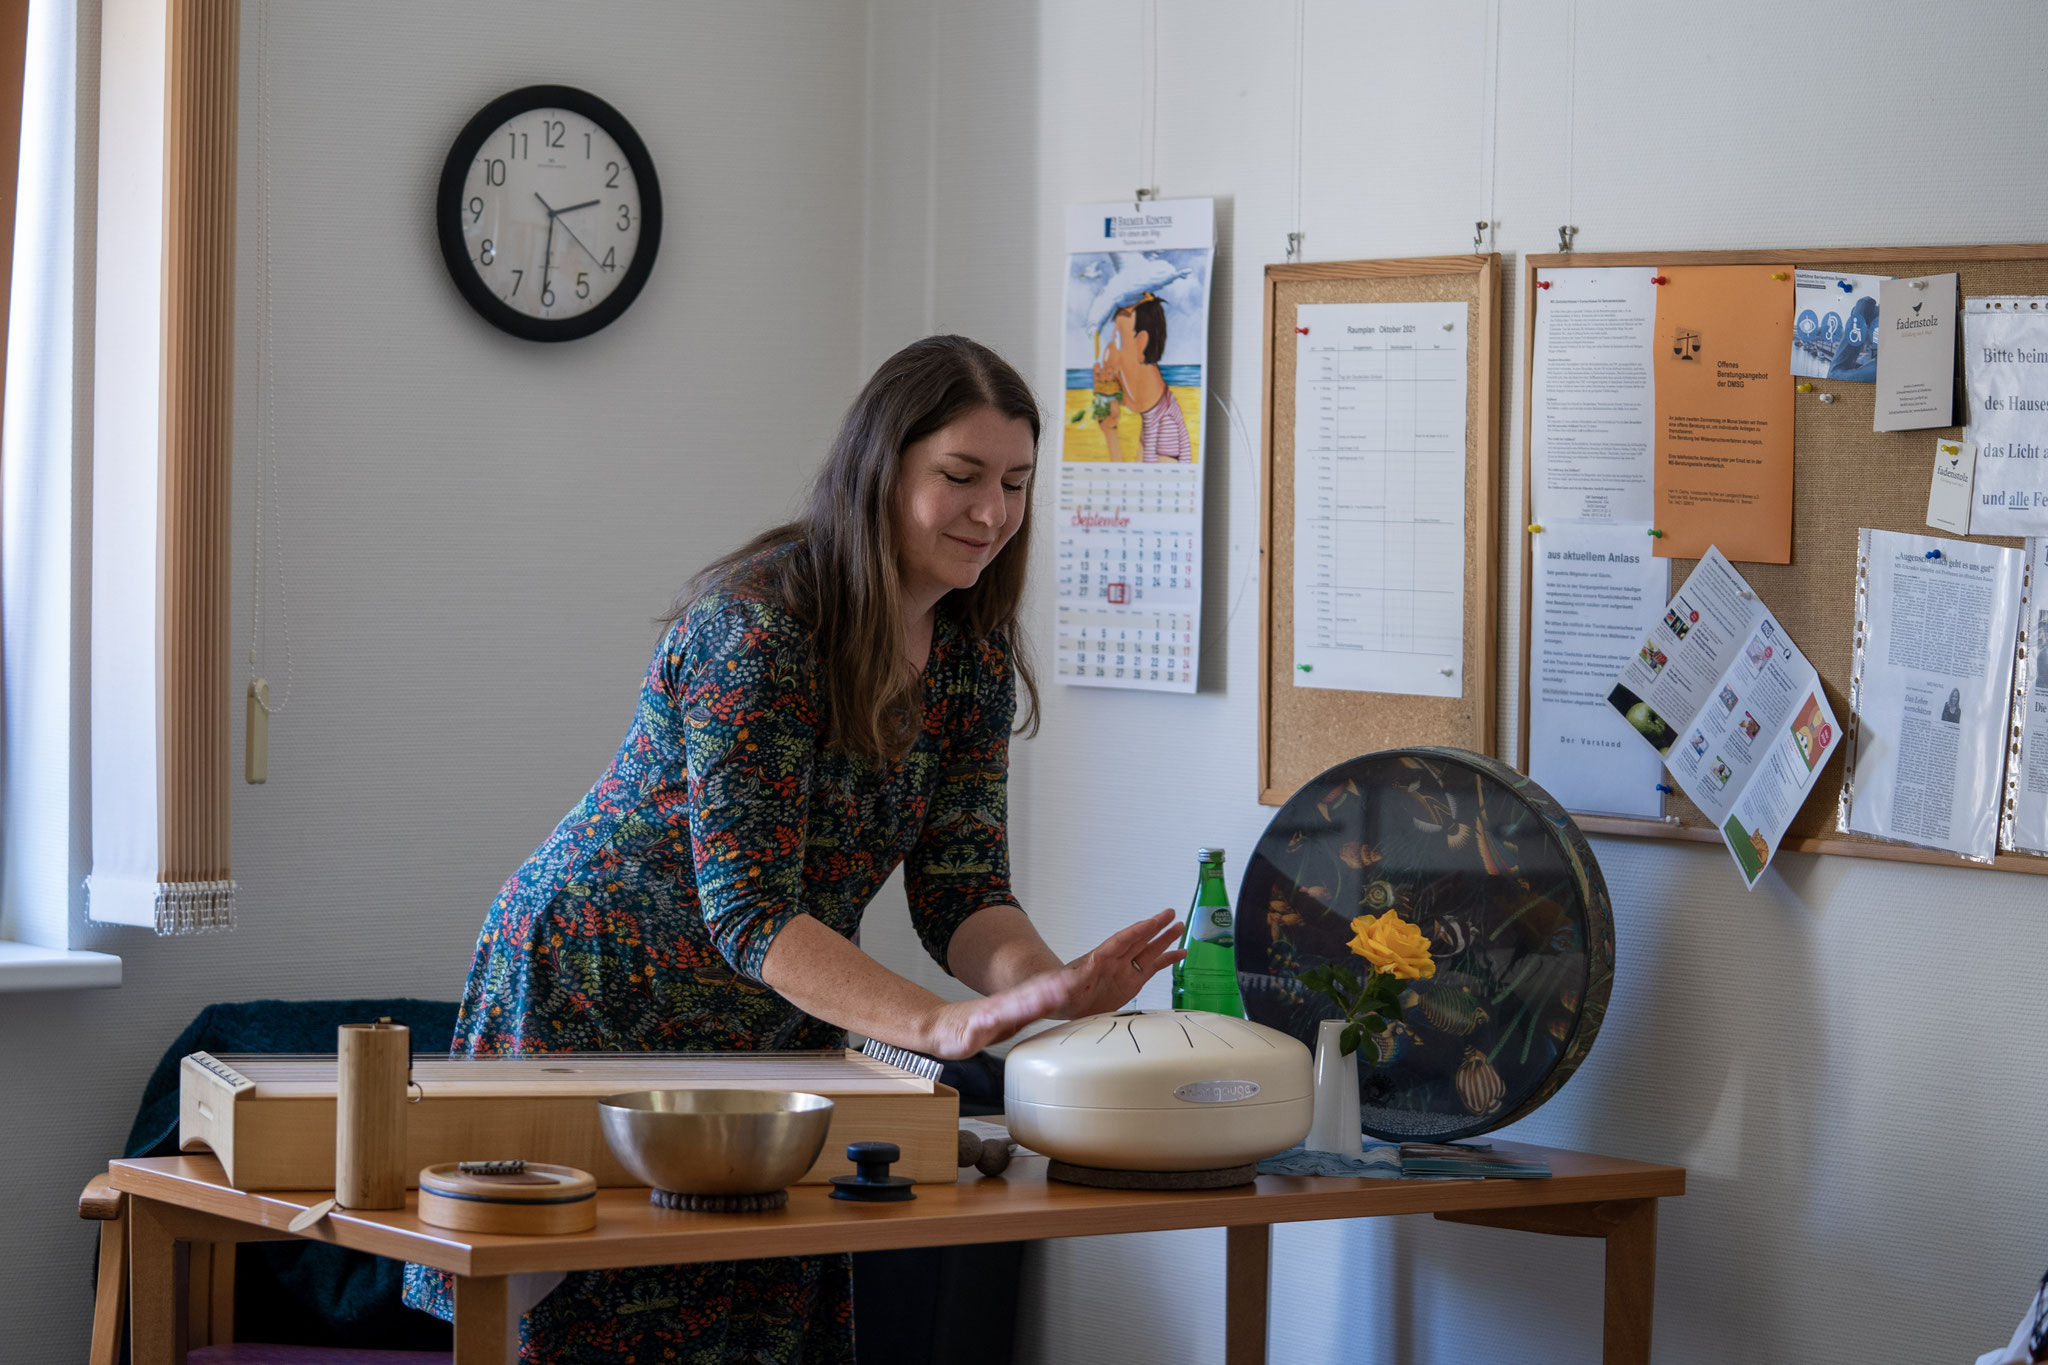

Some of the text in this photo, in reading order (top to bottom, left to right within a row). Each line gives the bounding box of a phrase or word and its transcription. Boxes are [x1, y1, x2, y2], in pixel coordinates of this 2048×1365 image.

[543, 120, 566, 148] 12
[509, 132, 528, 160] 11
[584, 132, 591, 160] 1
[484, 159, 506, 187] 10
[605, 161, 620, 189] 2
[470, 197, 484, 224] 9
[616, 204, 631, 232] 3
[480, 239, 495, 266] 8
[602, 246, 617, 273] 4
[512, 269, 523, 297] 7
[575, 272, 590, 300] 5
[540, 281, 556, 308] 6
[1347, 324, 1416, 335] Raumplan Oktober 2021
[1896, 315, 1938, 330] fadenstolz
[1983, 348, 2048, 363] Bitte beim
[1717, 361, 1739, 369] Offenes
[1717, 370, 1769, 381] Beratungsangebot
[1717, 380, 1745, 389] der DMSG
[1984, 396, 2005, 411] des
[1983, 443, 2004, 458] das
[2008, 443, 2039, 459] Licht
[1937, 465, 1969, 483] fadenstolz
[1982, 491, 2005, 506] und
[2009, 491, 2030, 507] alle
[1071, 505, 1131, 534] September
[1547, 550, 1640, 564] aus aktuellem Anlass
[1948, 560, 1961, 570] geht
[1969, 563, 1979, 571] uns
[2034, 701, 2047, 714] Die
[1560, 735, 1621, 748] Der Vorstand
